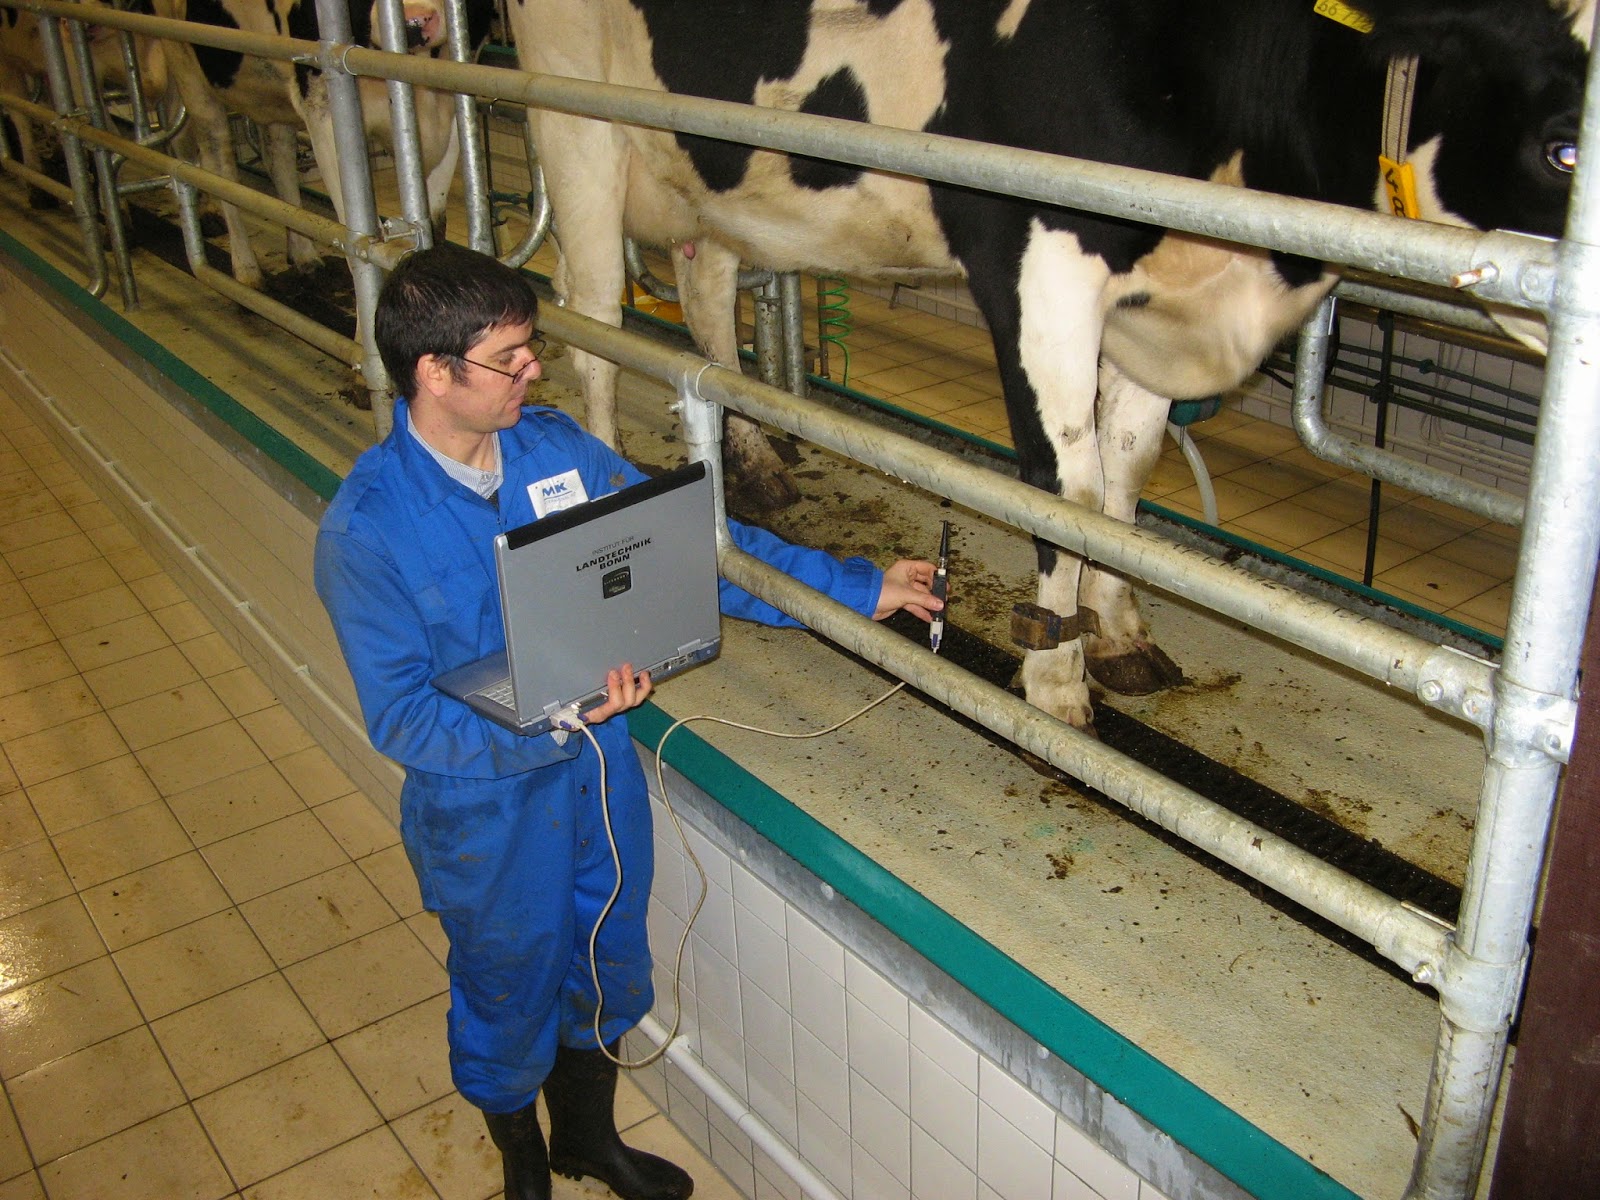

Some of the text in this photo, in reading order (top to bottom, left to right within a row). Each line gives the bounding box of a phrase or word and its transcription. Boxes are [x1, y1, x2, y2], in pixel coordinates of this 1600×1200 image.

[542, 482, 567, 497] MK
[576, 537, 651, 572] LANDTECHNIK
[592, 541, 620, 555] INSTITUT
[599, 553, 630, 570] BONN
